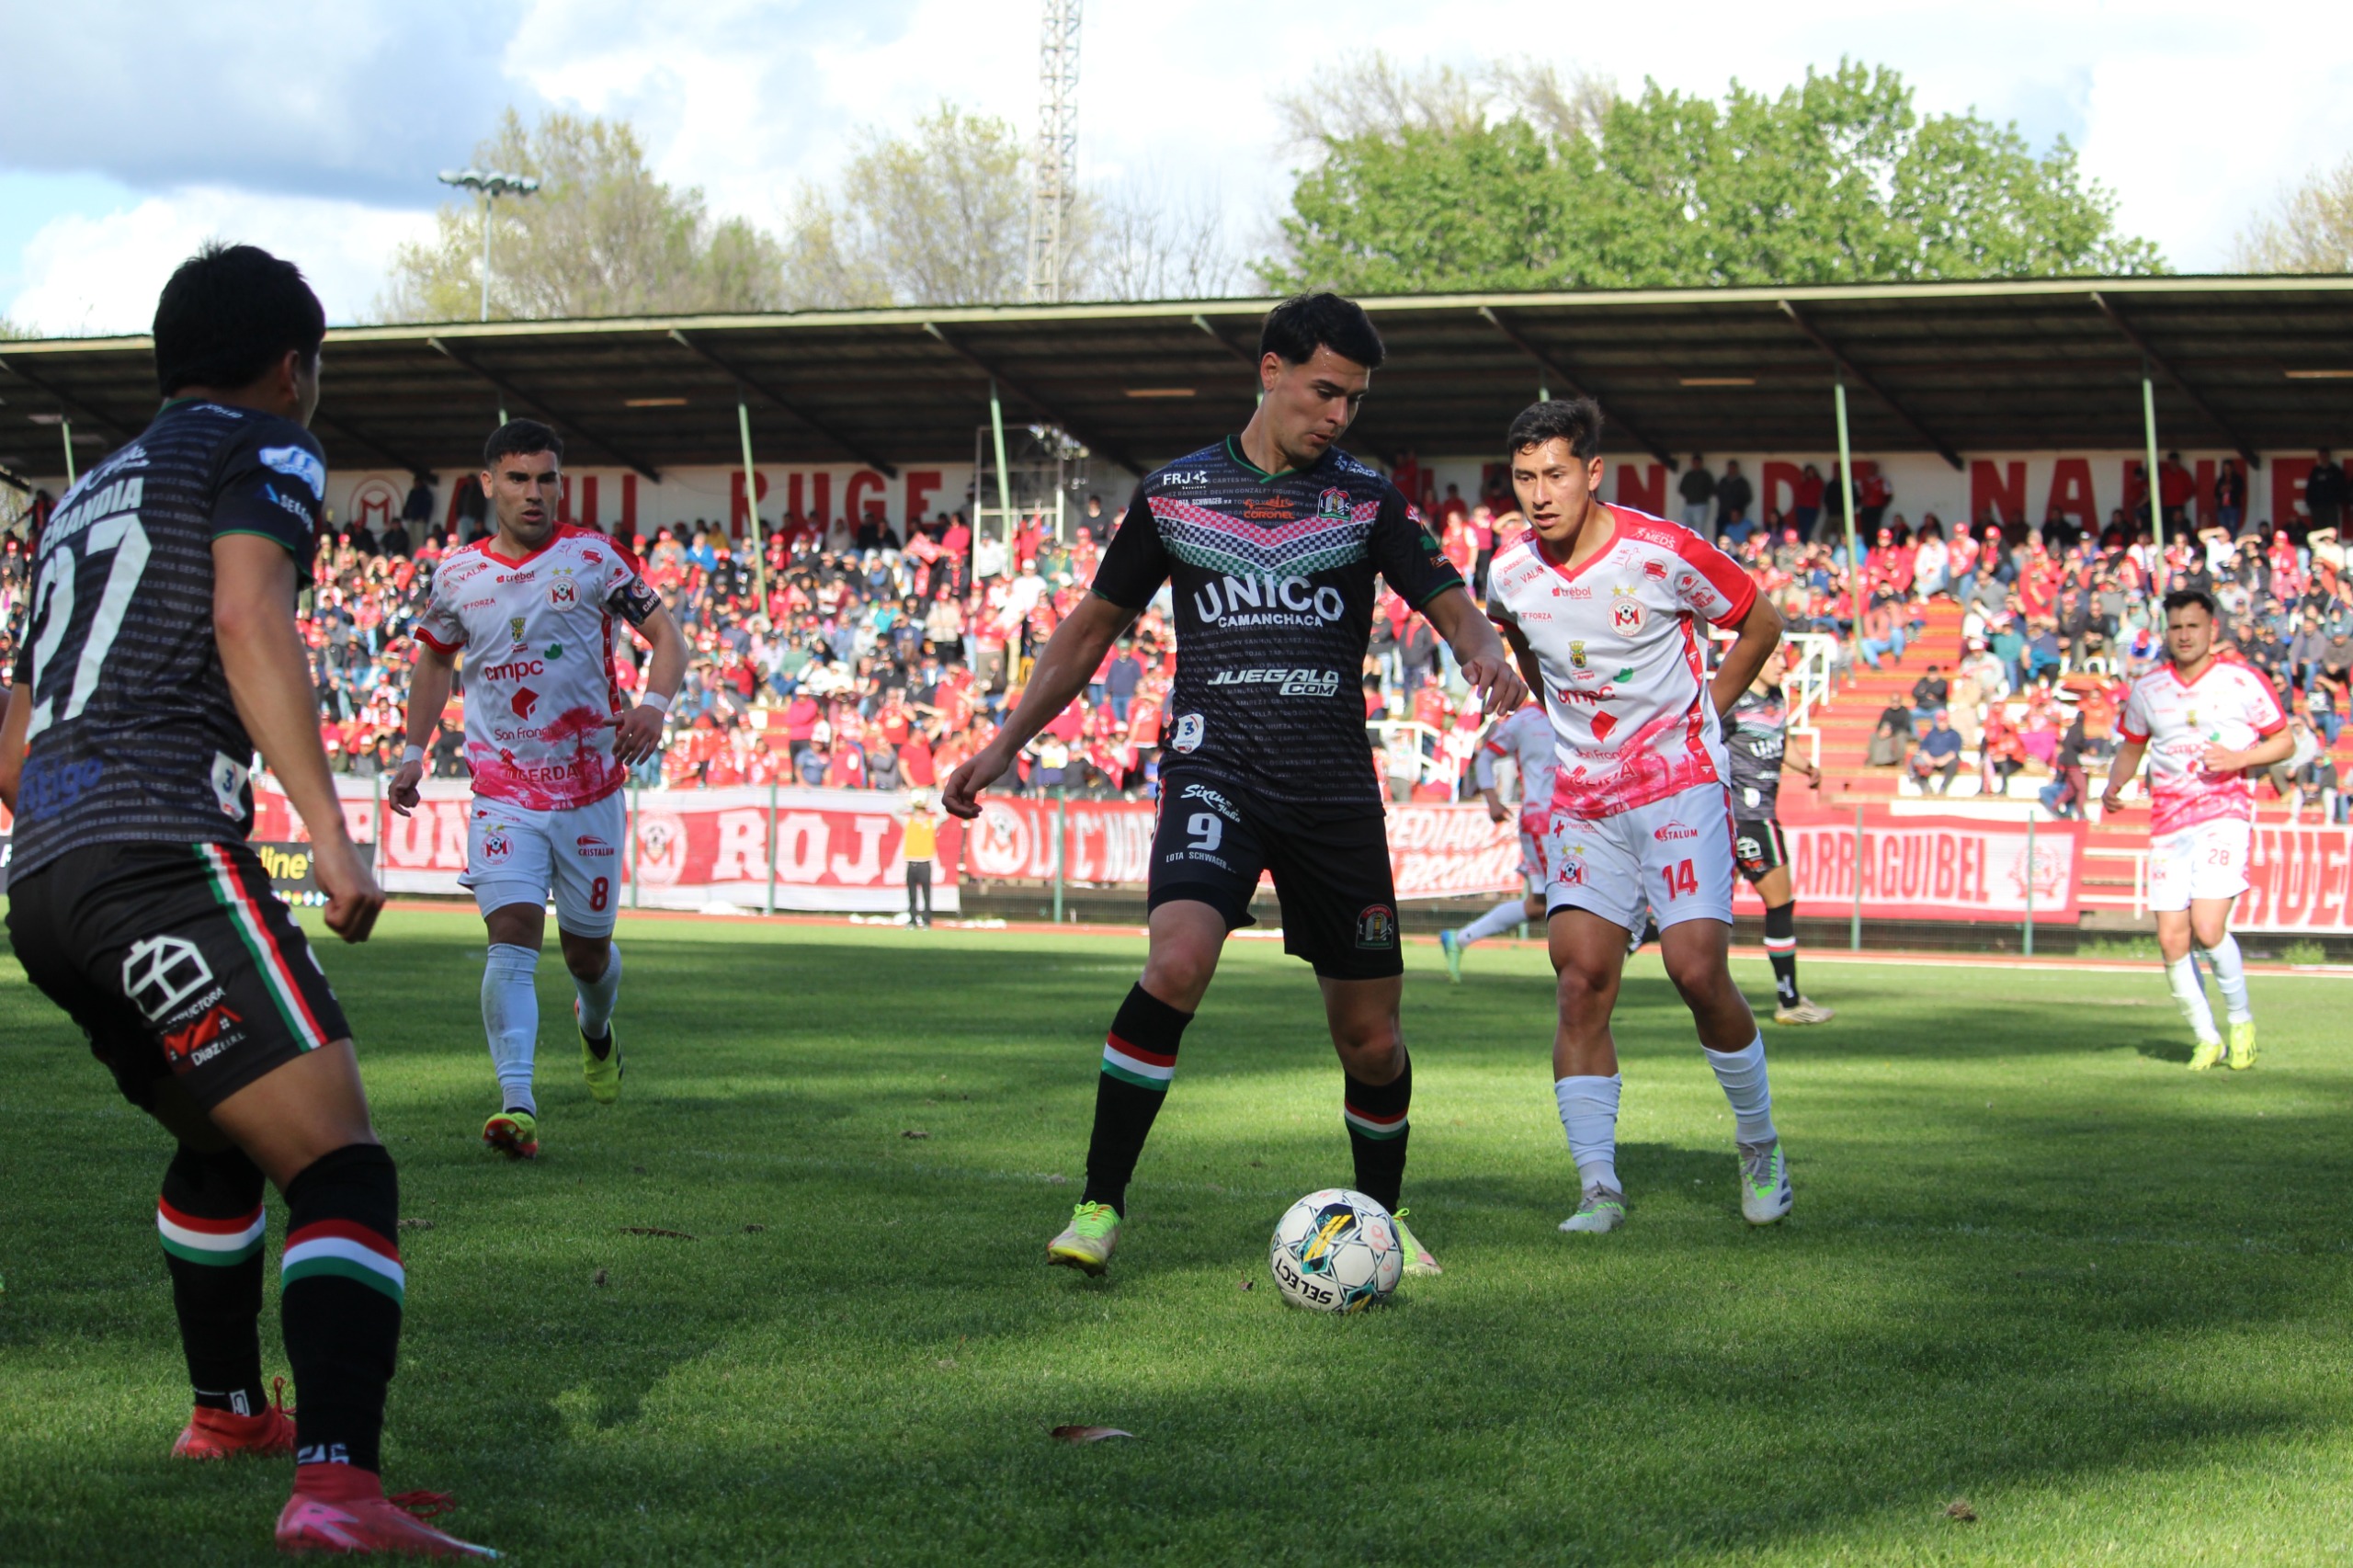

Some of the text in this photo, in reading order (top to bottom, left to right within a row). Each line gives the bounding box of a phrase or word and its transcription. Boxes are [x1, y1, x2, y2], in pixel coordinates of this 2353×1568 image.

[1163, 472, 1191, 485] FRJ
[732, 471, 942, 540] RUGE
[1244, 510, 1296, 519] CORONEL
[39, 476, 144, 561] CHANDIA
[506, 571, 535, 582] trébol
[1194, 573, 1344, 623] UNICO
[1562, 586, 1592, 597] trébol
[470, 597, 496, 608] FORZA
[25, 513, 152, 744] 27
[1218, 613, 1324, 628] CAMANCHACA
[484, 660, 544, 683] cmpc
[1207, 669, 1339, 686] JUEGALO
[494, 728, 516, 742] San
[1185, 722, 1195, 735] 3
[222, 768, 234, 792] 3
[1187, 812, 1222, 851] 9
[1165, 851, 1228, 869] LOTA SCHWAGER
[2208, 847, 2230, 866] 28
[1662, 858, 1699, 903] 14
[589, 876, 609, 912] 8
[1275, 1257, 1334, 1304] SELECT
